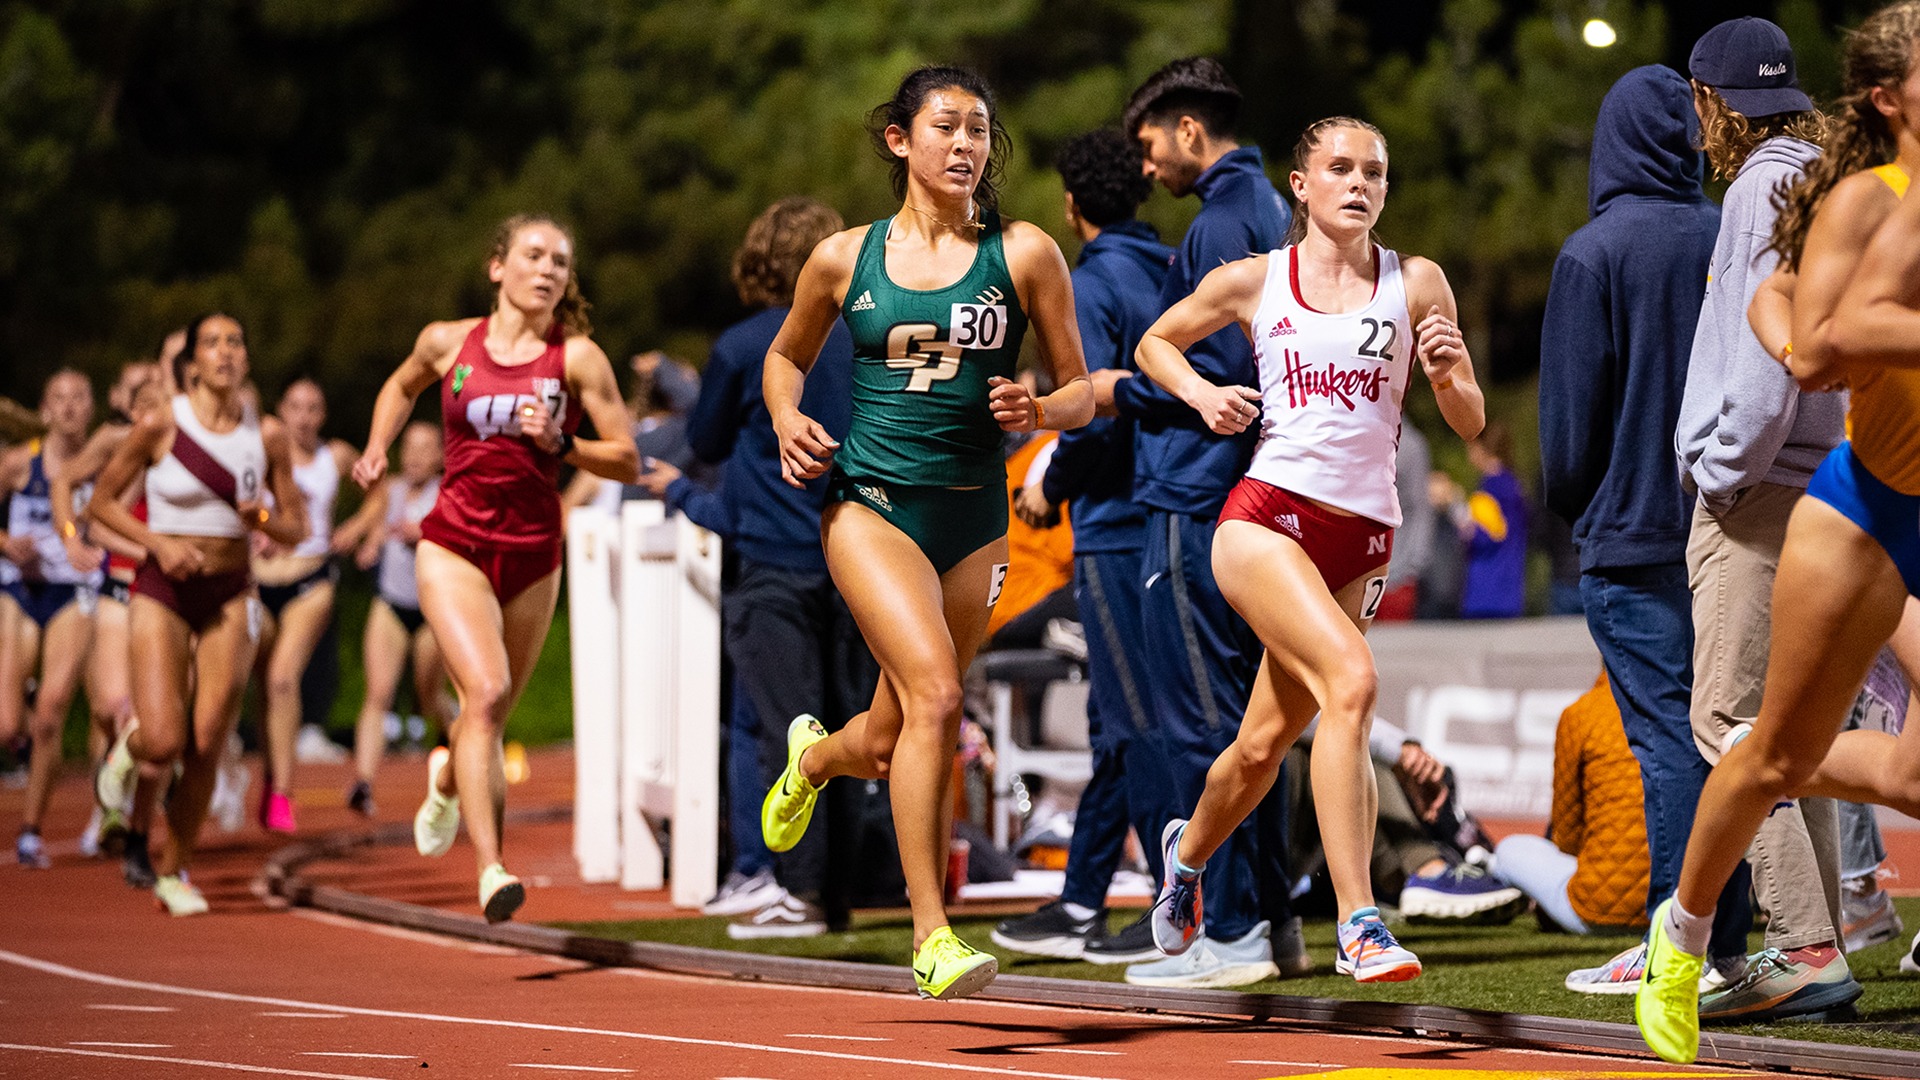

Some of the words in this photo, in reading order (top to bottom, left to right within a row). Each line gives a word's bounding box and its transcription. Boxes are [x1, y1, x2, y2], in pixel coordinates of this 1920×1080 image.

[1758, 62, 1787, 77] Vissla
[851, 301, 876, 312] adidas
[957, 306, 998, 347] 30
[1268, 328, 1298, 338] adidas
[1357, 317, 1397, 362] 22
[1282, 348, 1390, 412] Huskers
[858, 487, 893, 512] adidas
[1274, 515, 1303, 539] adidas
[1366, 533, 1387, 555] N
[1365, 578, 1388, 617] 2
